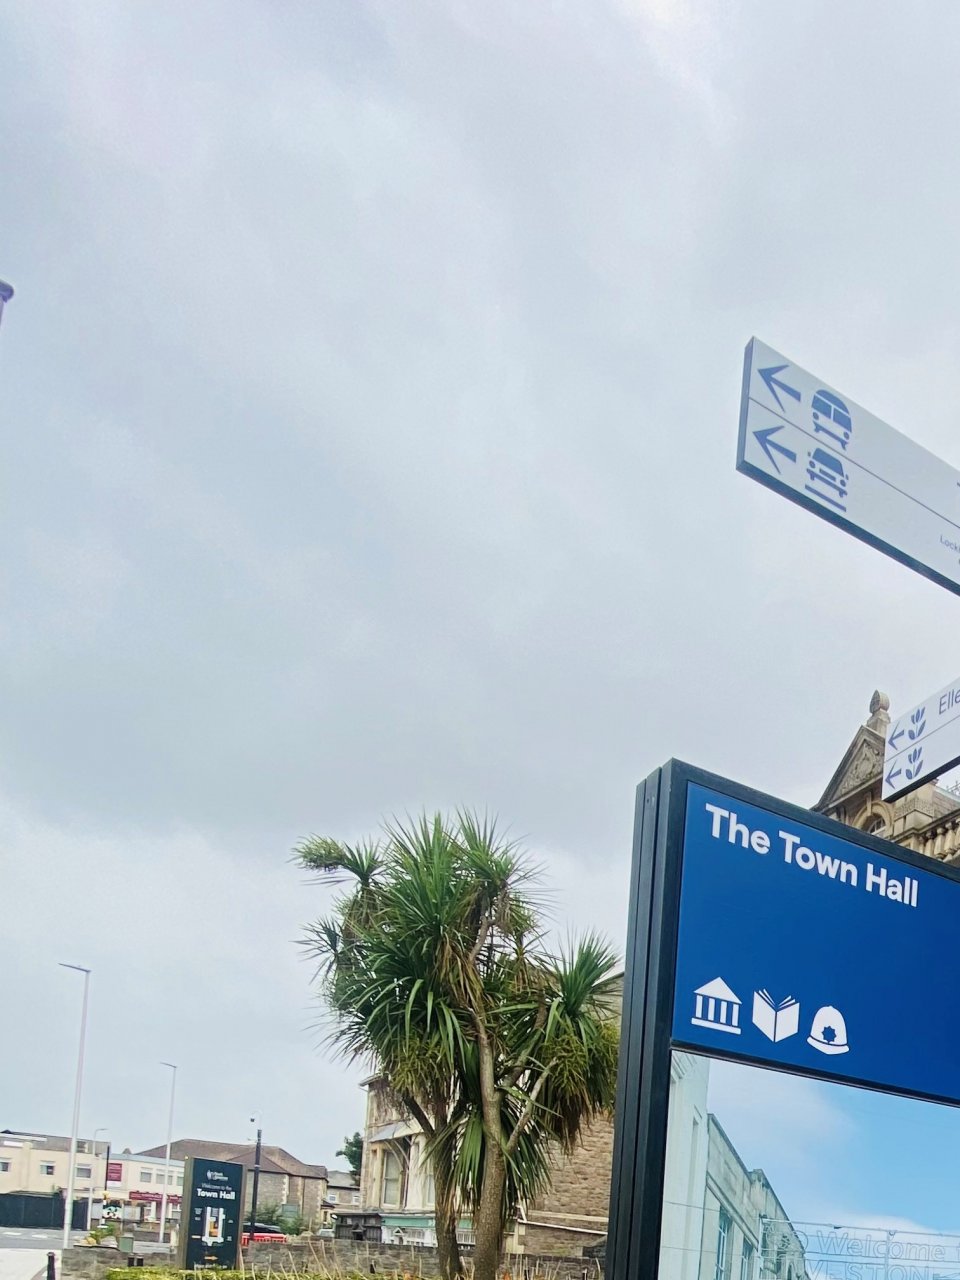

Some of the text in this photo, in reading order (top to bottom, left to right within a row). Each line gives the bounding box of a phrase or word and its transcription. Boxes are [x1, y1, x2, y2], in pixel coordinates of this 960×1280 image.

[705, 802, 919, 908] The Town Hall
[196, 1188, 236, 1200] Town Hall
[815, 1230, 946, 1262] Welcome
